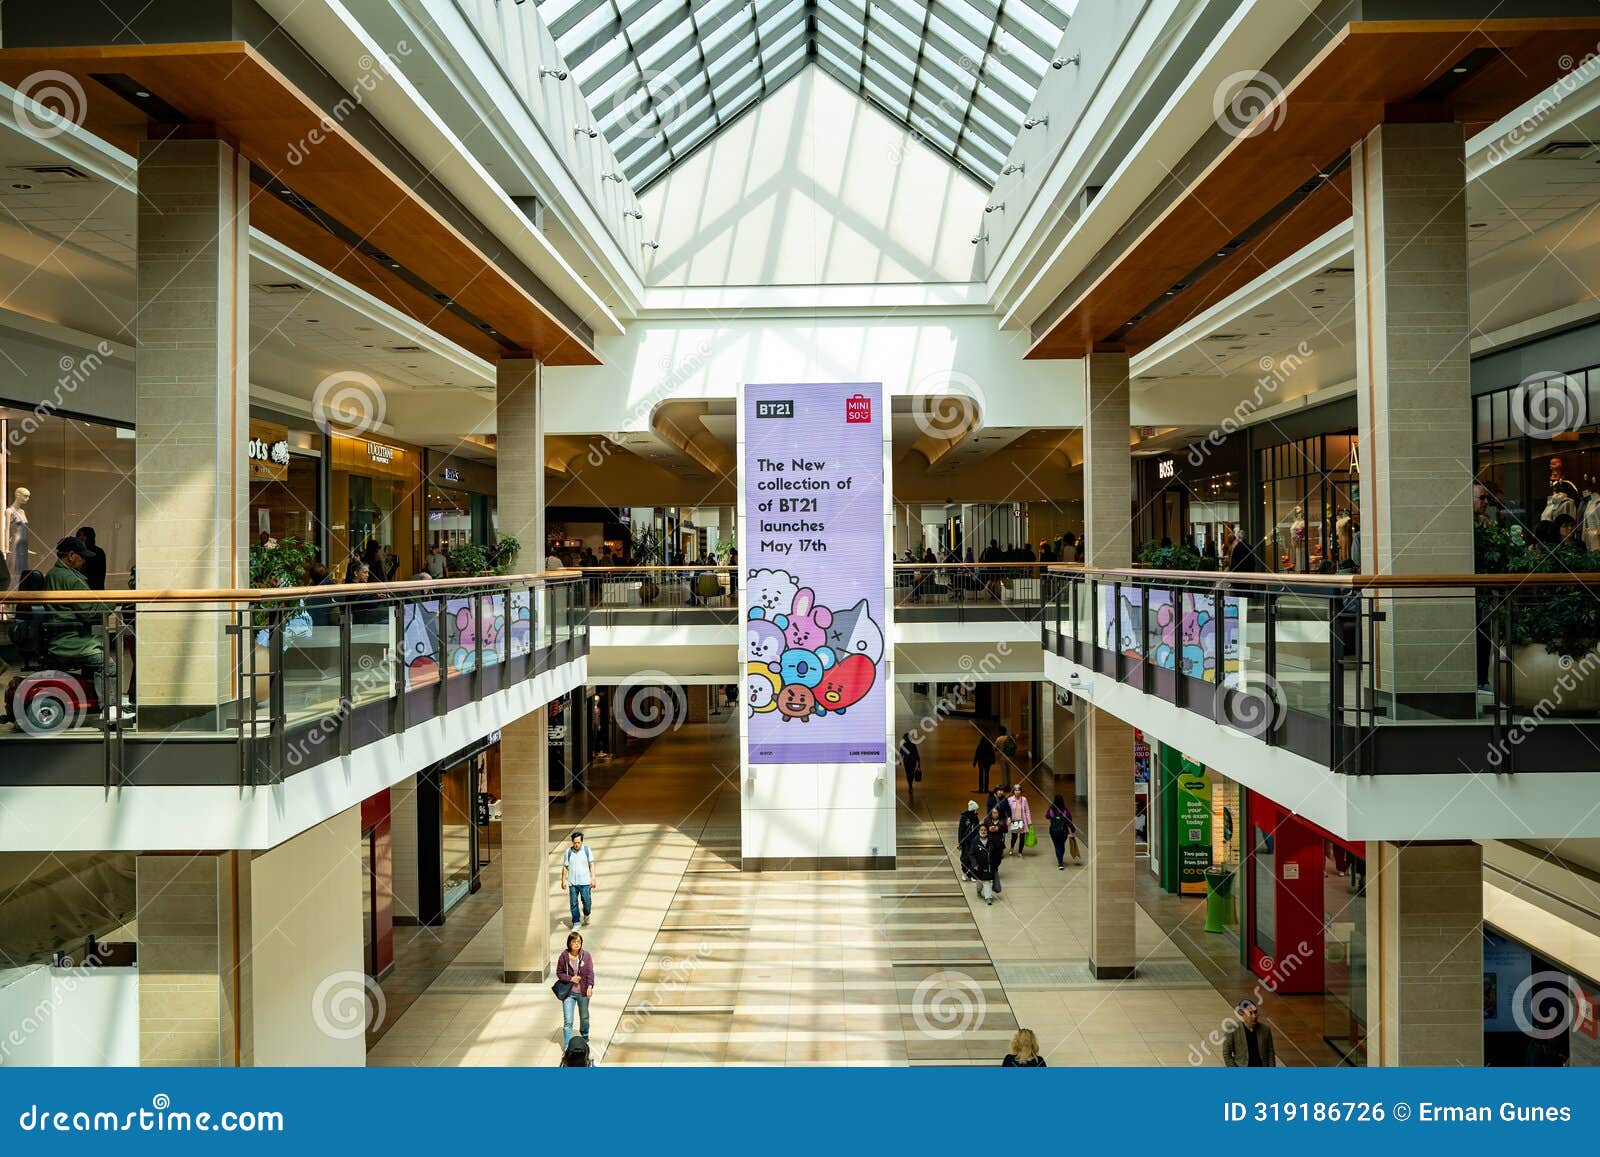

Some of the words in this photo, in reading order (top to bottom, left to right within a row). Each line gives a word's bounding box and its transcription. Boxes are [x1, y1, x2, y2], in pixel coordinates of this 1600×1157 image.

[759, 403, 791, 415] BT21
[848, 402, 869, 410] MINI
[757, 458, 785, 472] The
[791, 458, 825, 472] New
[1159, 460, 1174, 479] BOSS
[757, 477, 830, 491] collection
[836, 476, 852, 490] of
[758, 499, 773, 512] of
[779, 498, 817, 513] BT21
[760, 519, 825, 532] launches
[760, 539, 793, 556] May
[799, 539, 827, 552] 17th
